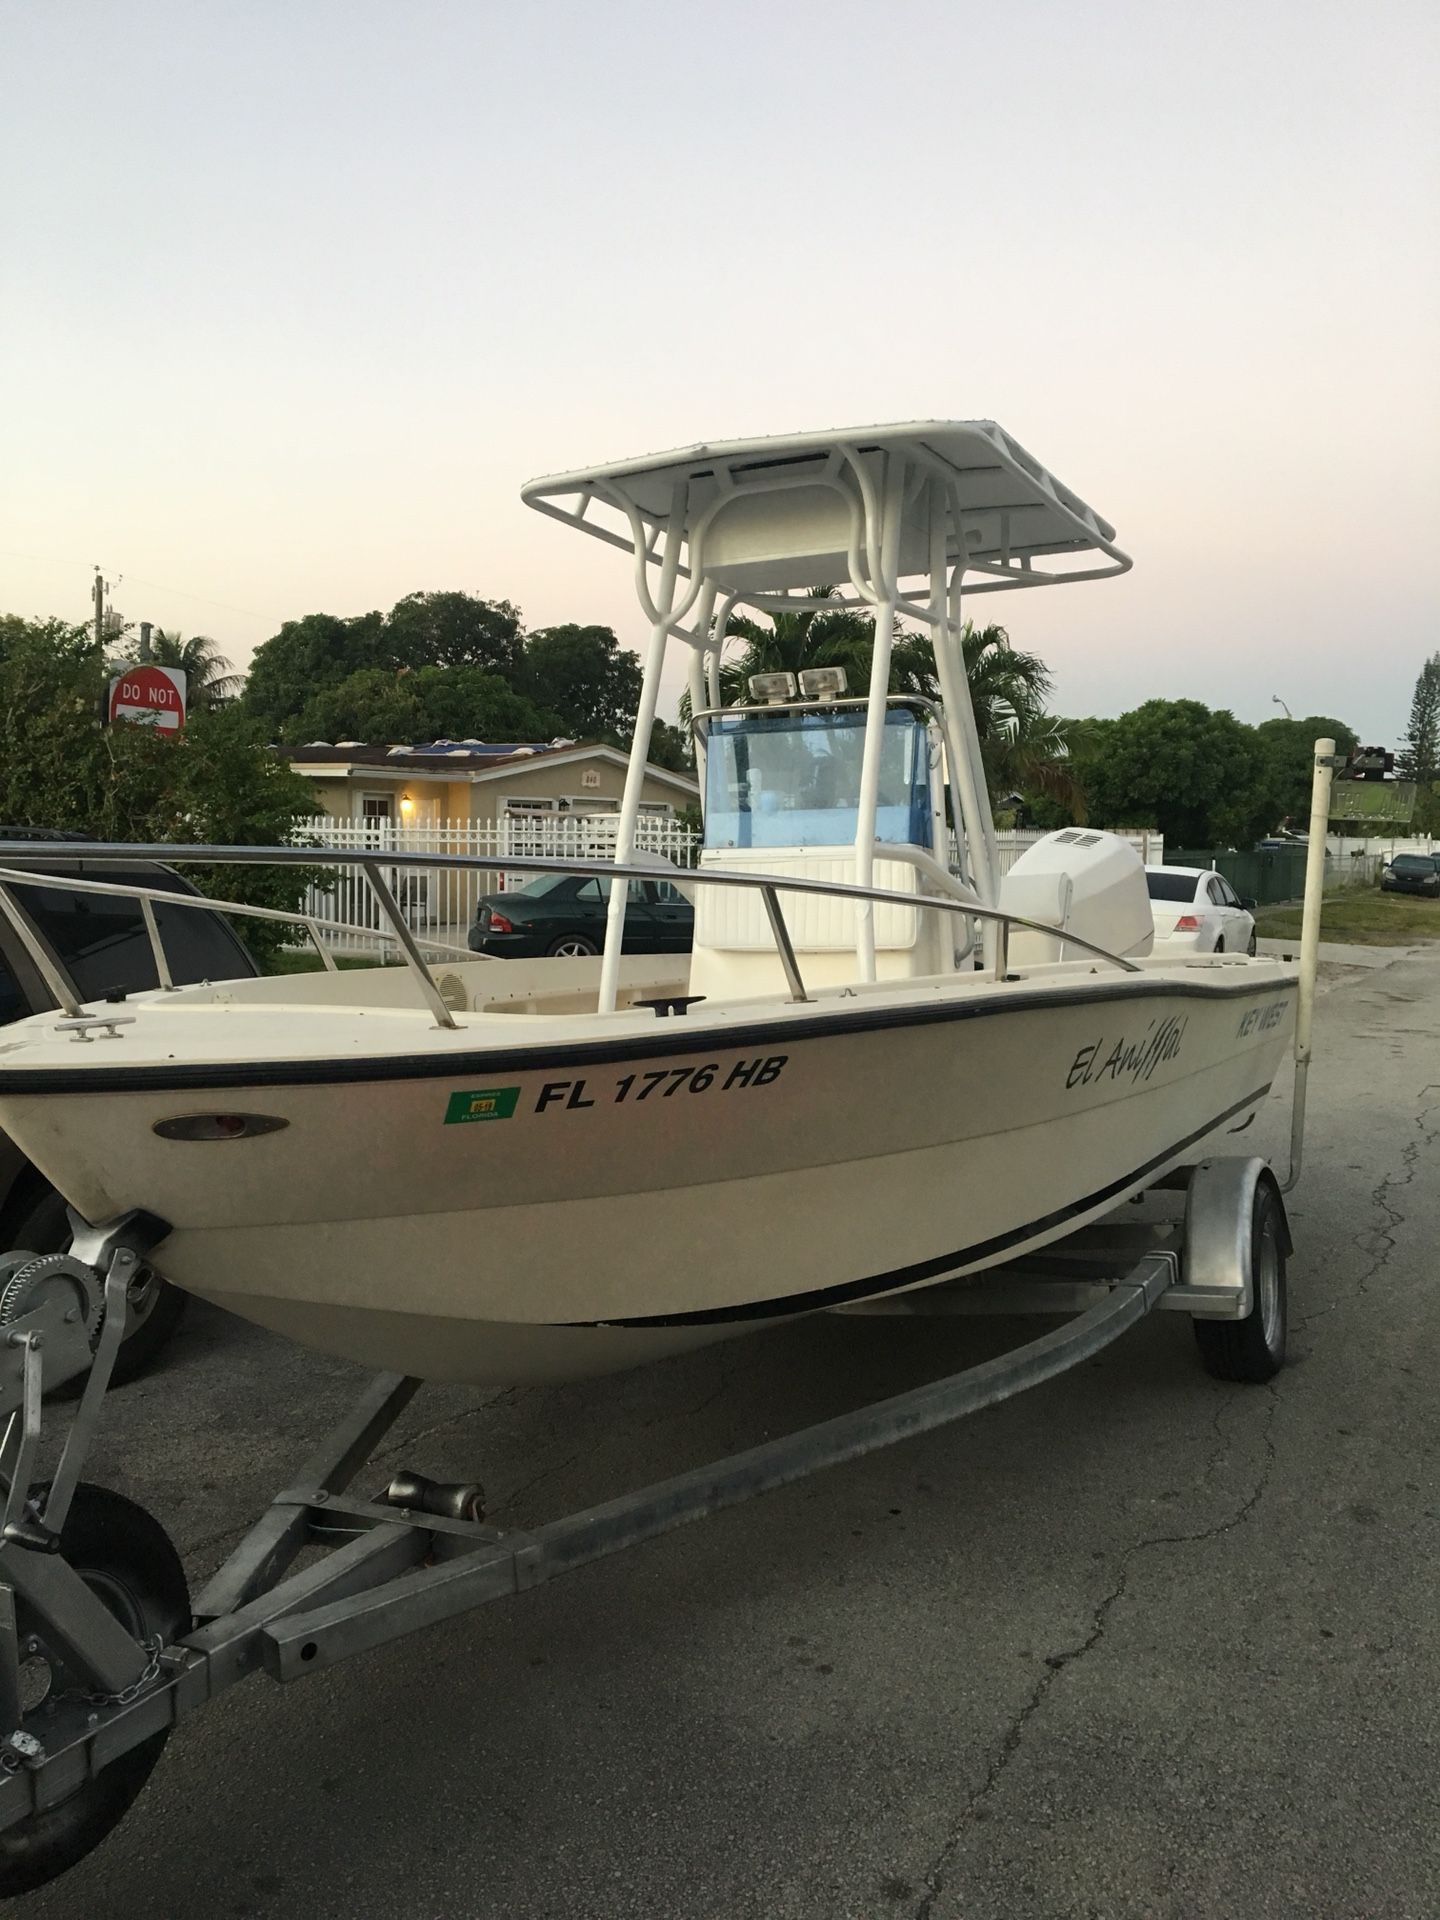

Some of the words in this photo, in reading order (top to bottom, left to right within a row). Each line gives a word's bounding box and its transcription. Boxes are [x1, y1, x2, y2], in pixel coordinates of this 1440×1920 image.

[122, 683, 140, 700] DO
[149, 686, 174, 705] NOT
[535, 1080, 595, 1113] FL
[614, 1064, 719, 1103] 1776
[721, 1056, 789, 1091] HB
